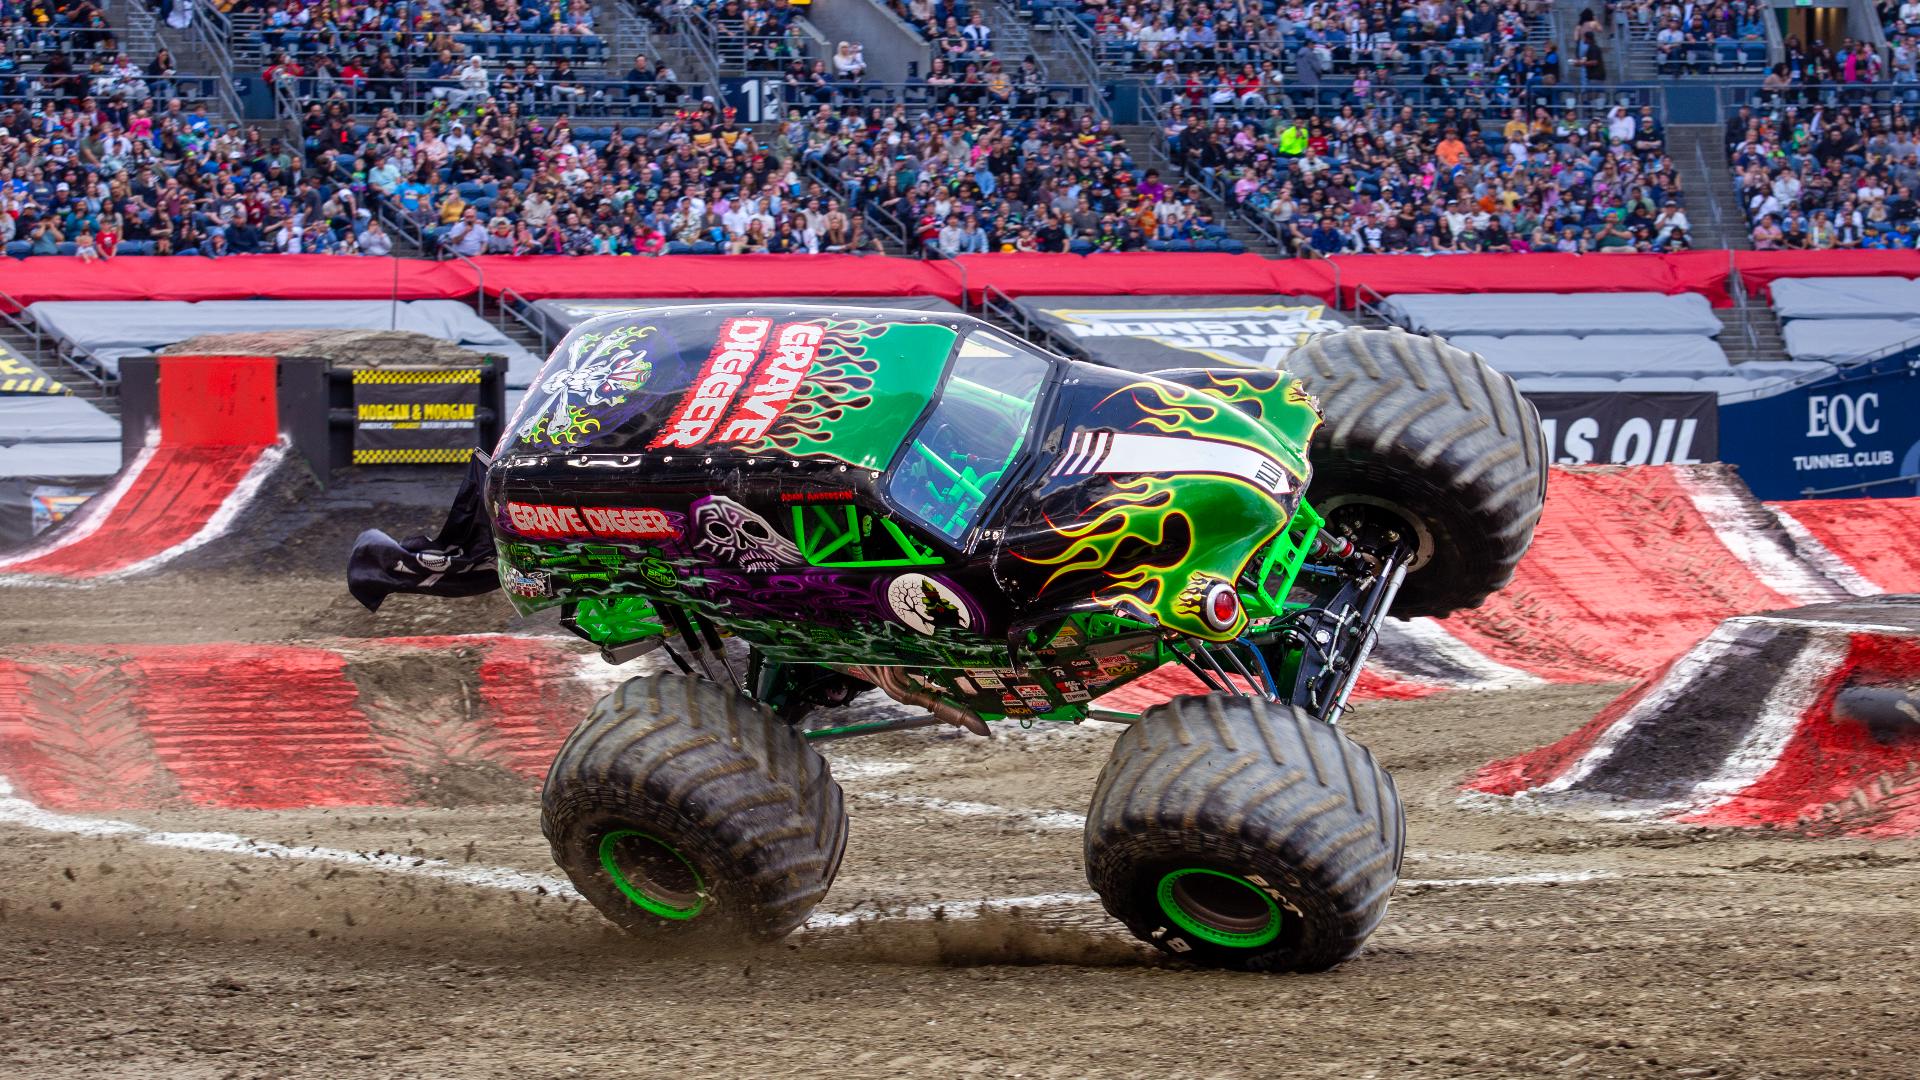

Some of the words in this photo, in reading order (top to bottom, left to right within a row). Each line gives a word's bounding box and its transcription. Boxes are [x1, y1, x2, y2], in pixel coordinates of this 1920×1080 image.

[1064, 318, 1346, 338] MONSTER
[1170, 333, 1298, 348] JAM
[661, 319, 770, 446] DIGGER
[718, 323, 824, 442] GRAVE
[358, 403, 410, 420] MORGAN
[411, 403, 422, 420] &
[423, 403, 475, 420] MORGAN
[1806, 392, 1880, 448] EQC
[1610, 417, 1701, 466] OIL
[1793, 452, 1854, 471] TUNNEL
[1854, 450, 1894, 467] CLUB
[508, 502, 589, 533] GRAVE
[582, 508, 675, 533] DIGGER
